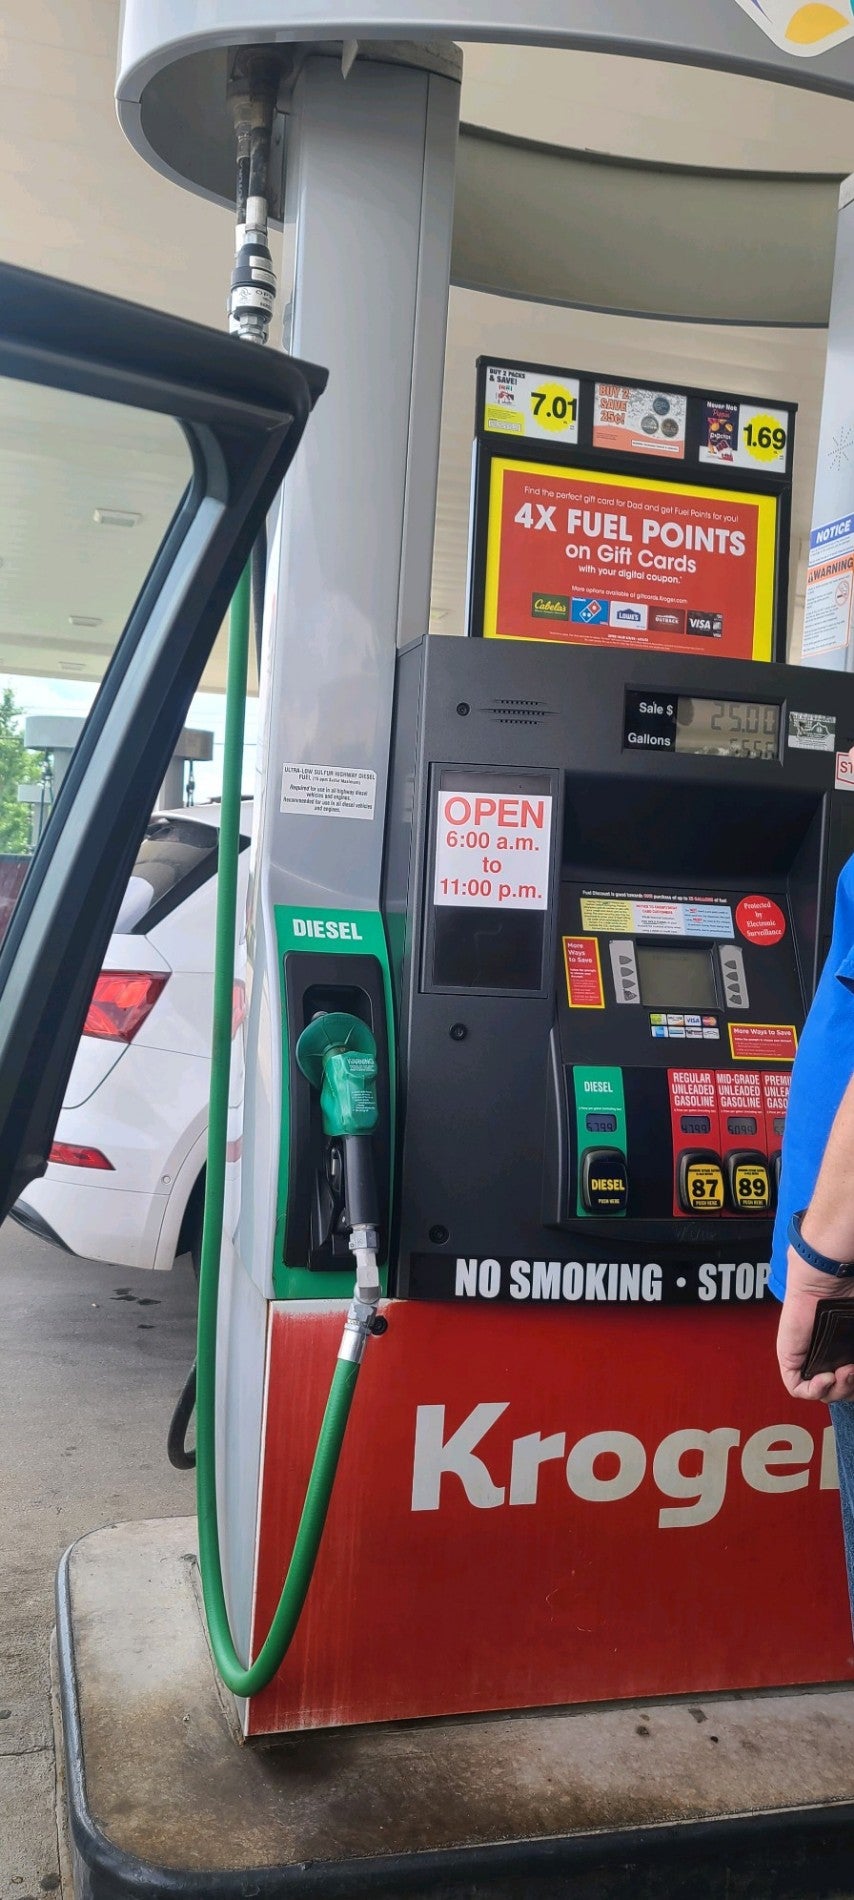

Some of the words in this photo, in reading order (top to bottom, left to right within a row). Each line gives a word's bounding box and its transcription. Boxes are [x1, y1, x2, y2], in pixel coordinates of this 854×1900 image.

[496, 376, 518, 385] SAVE!
[508, 371, 526, 379] PACKS
[599, 384, 621, 397] BUY
[622, 389, 630, 399] 2
[531, 391, 578, 421] 7.01
[600, 398, 627, 412] SAVE
[743, 423, 786, 450] 1.69
[524, 486, 541, 495] Find
[542, 489, 554, 498] the
[556, 491, 582, 501] perfect
[584, 495, 596, 504] gift
[597, 496, 615, 506] card
[616, 499, 626, 507] for
[627, 500, 643, 510] Dad
[644, 504, 660, 512] and
[661, 506, 673, 515] get
[674, 507, 690, 516] Fuel
[691, 509, 711, 520] Points
[712, 512, 722, 520] for
[723, 514, 739, 523] you!
[514, 502, 557, 532] 4X
[567, 508, 633, 542] FUEL
[642, 518, 746, 557] POINTS
[815, 519, 852, 545] NOTICE
[565, 543, 591, 560] on
[597, 544, 633, 565] Gift
[637, 549, 697, 574] Cards
[578, 565, 596, 574] with
[598, 568, 617, 577] your
[618, 569, 645, 580] digital
[812, 556, 854, 580] WARNING
[586, 587, 605, 595] options
[605, 589, 629, 597] available
[689, 618, 711, 630] VISA
[639, 701, 664, 715] Sale
[666, 703, 674, 716] $
[627, 732, 672, 747] Gallons
[358, 772, 376, 780] DIESEL
[290, 783, 310, 791] Required
[444, 796, 545, 829] OPEN
[446, 830, 490, 849] 6:00
[496, 836, 540, 851] a.m.
[482, 856, 502, 873] to
[440, 878, 492, 897] 11:00
[498, 883, 542, 901] p.m.
[743, 901, 771, 909] Protected
[755, 911, 762, 919] by
[292, 918, 363, 941] DIESEL
[746, 920, 776, 928] Electronic
[746, 929, 782, 937] Surveillance
[568, 949, 586, 957] Ways
[750, 1028, 768, 1036] Ways
[673, 1072, 712, 1084] REGULAR
[716, 1073, 760, 1085] MID-GRADE
[584, 1081, 614, 1093] DIESEL
[671, 1083, 715, 1095] UNLEADED
[718, 1085, 761, 1096] UNLEADED
[674, 1095, 715, 1107] GASOLINE
[721, 1096, 761, 1108] GASOLINE
[591, 1179, 625, 1191] DIESEL
[691, 1178, 719, 1198] 87
[738, 1178, 766, 1197] 89
[454, 1258, 501, 1298] NO
[509, 1258, 663, 1301] SMOKING
[698, 1262, 771, 1300] STOP
